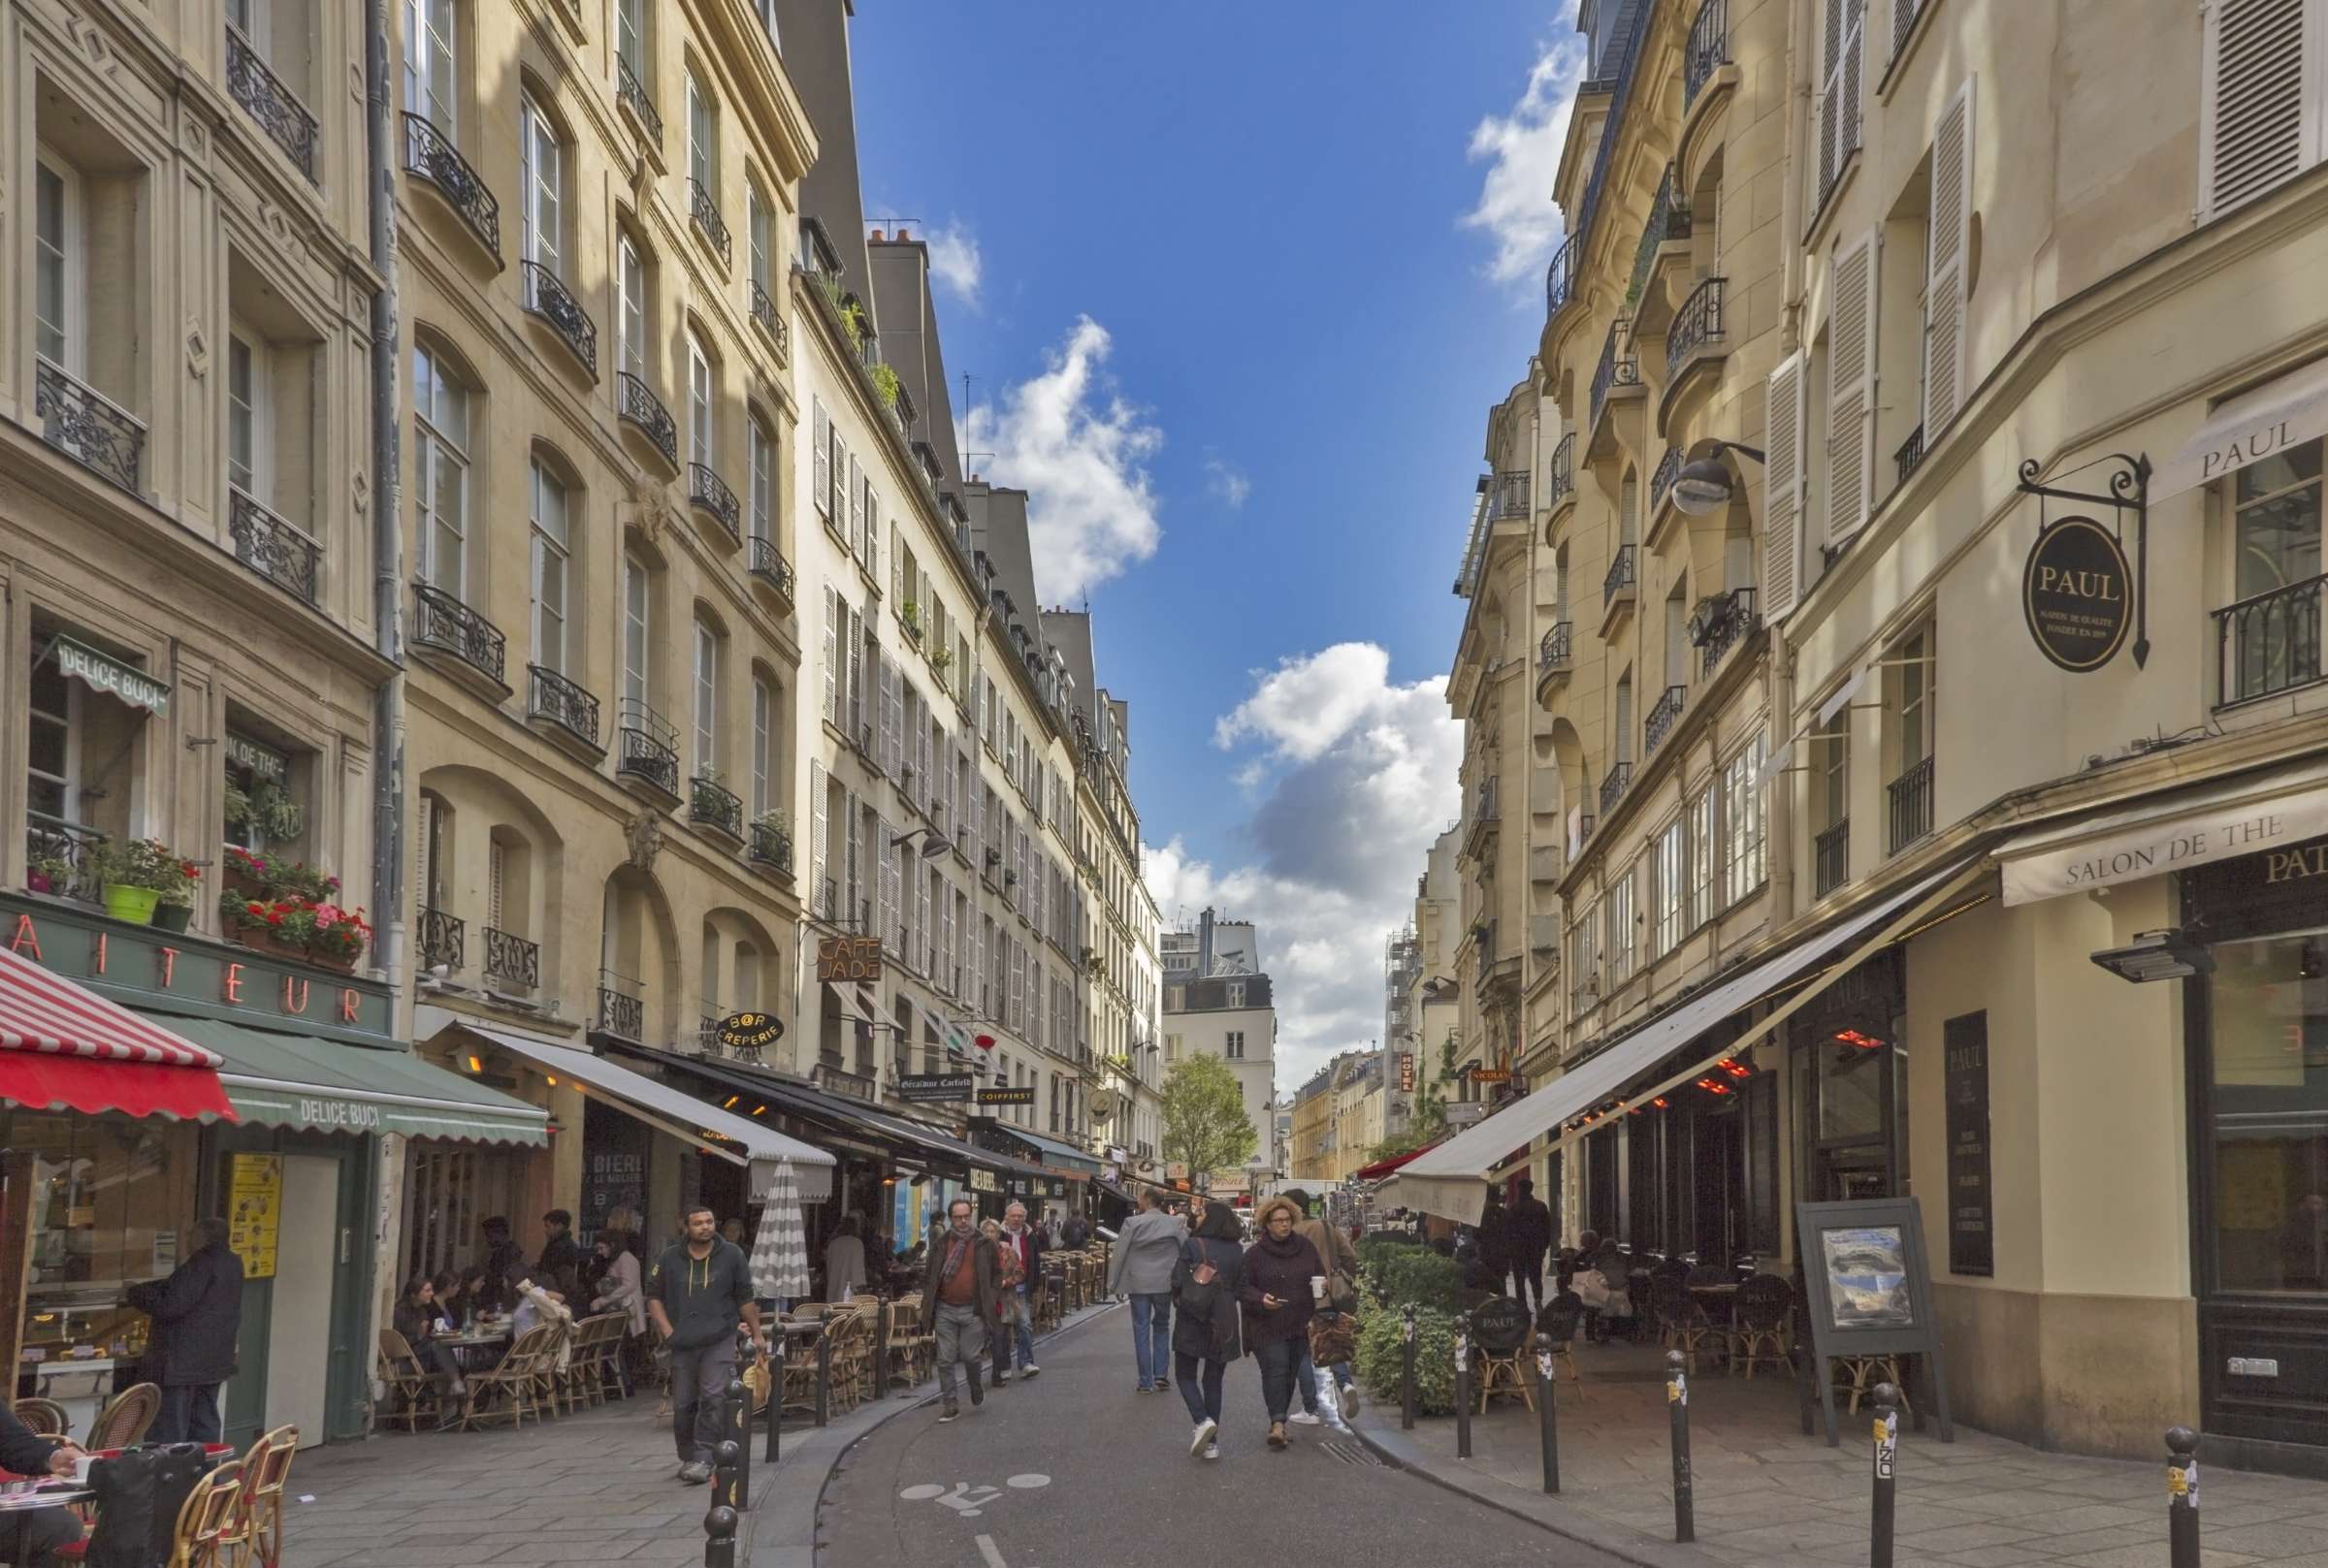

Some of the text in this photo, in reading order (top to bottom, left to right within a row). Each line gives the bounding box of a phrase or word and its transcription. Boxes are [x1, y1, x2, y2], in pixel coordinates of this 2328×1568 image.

[2203, 421, 2297, 477] PAUL
[2039, 566, 2119, 601] PAUL
[64, 644, 158, 707] DELICE BUCI
[241, 744, 256, 767] DE
[2066, 816, 2283, 885] SALON DE THE
[819, 939, 879, 960] CAFE
[821, 961, 879, 978] JADE
[717, 1026, 779, 1045] CREPERIE
[1402, 1055, 1412, 1091] HOTEL
[979, 1092, 1031, 1101] COIFFIRST
[301, 1098, 381, 1127] DELICE BUCI
